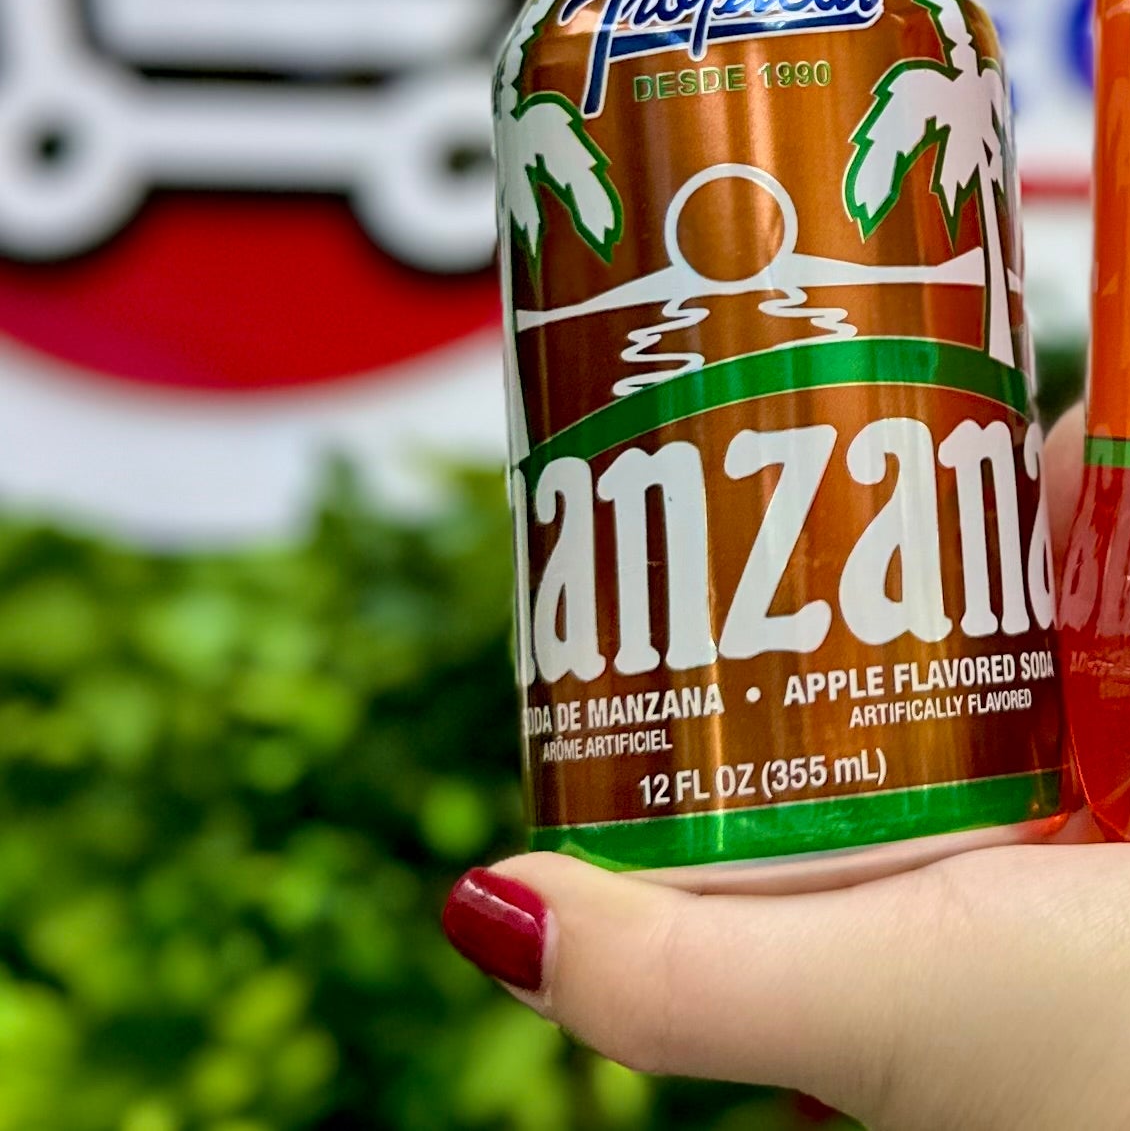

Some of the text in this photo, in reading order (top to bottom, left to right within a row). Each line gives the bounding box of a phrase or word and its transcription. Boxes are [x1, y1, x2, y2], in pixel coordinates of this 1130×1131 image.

[633, 60, 832, 102] DESDE 1990
[513, 417, 1056, 686] anzan
[782, 650, 1055, 707] APPLE FLAVORED SODA
[523, 684, 725, 734] ODA DE MANZANA
[848, 687, 1033, 728] ARTIFICALLY FLAVORED
[543, 728, 673, 762] ARÔME ARTIFICIEL
[639, 748, 887, 807] 12 FL OZ (355 mL)
